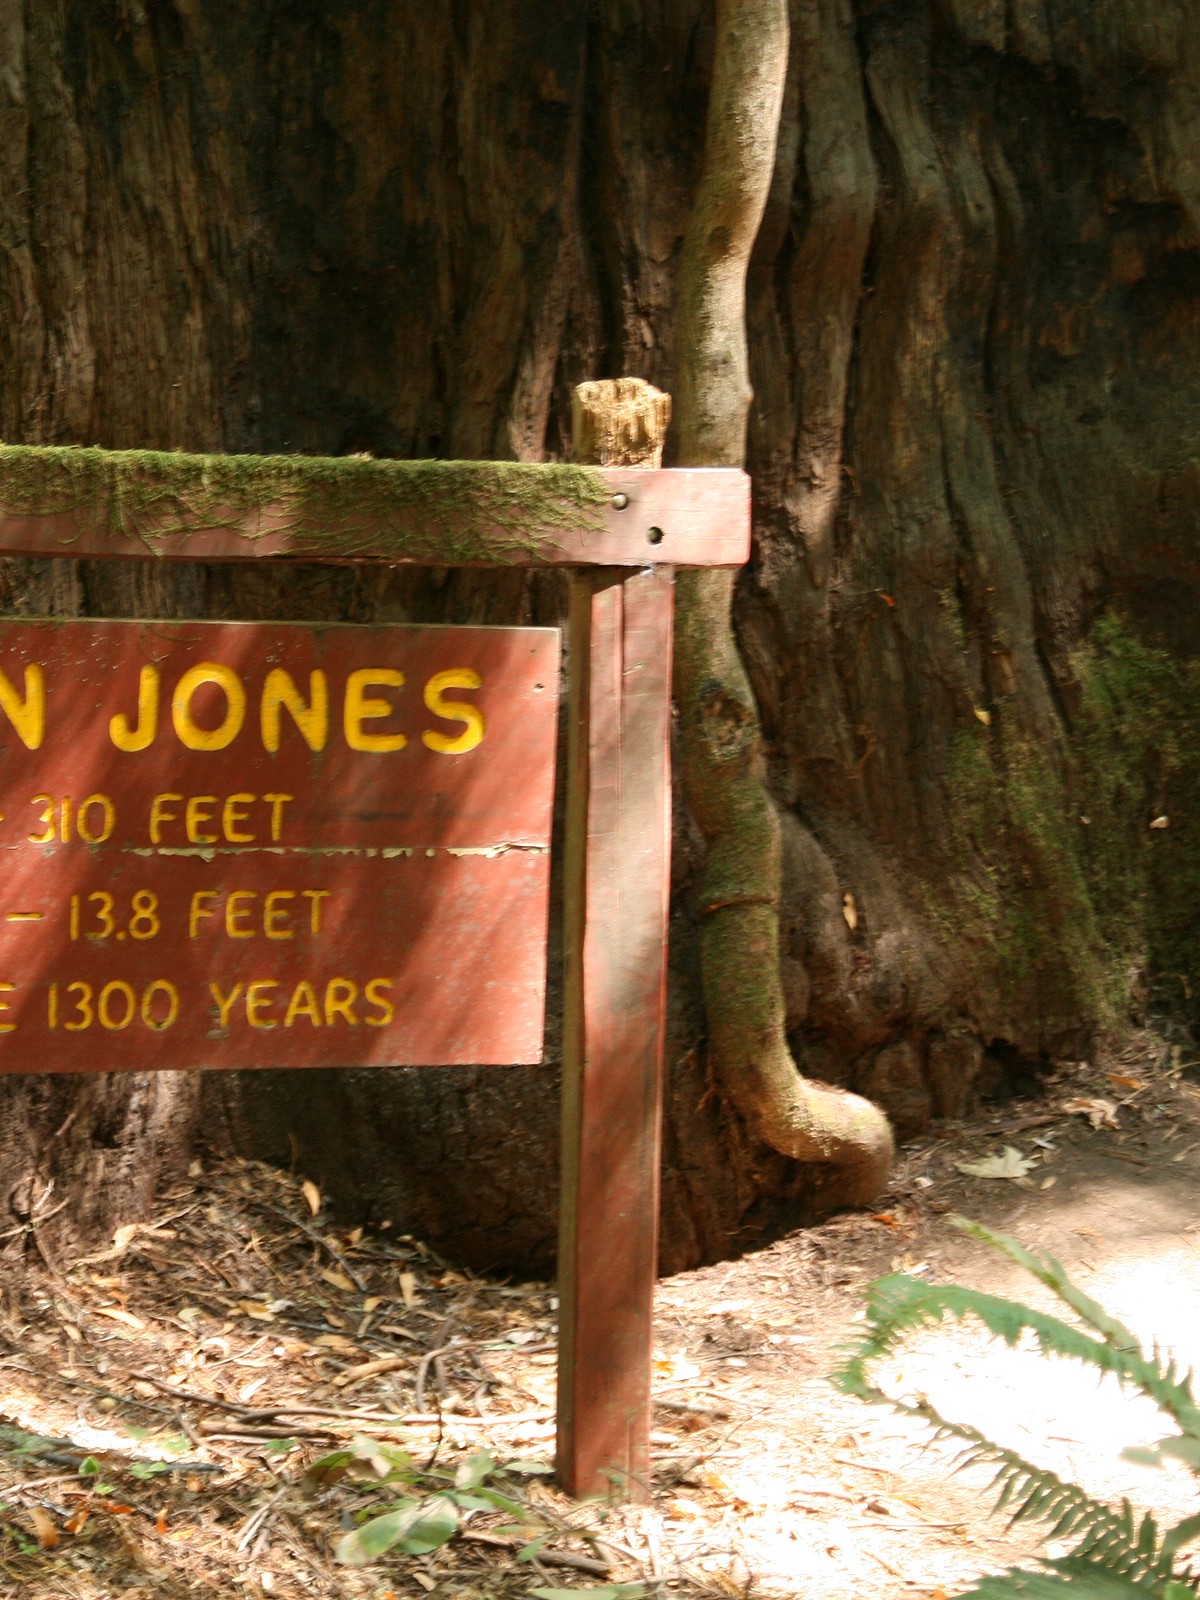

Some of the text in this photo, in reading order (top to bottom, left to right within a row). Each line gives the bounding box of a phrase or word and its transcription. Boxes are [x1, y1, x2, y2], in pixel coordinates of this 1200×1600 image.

[108, 661, 487, 755] JONES
[27, 792, 117, 845] 310
[148, 792, 294, 845] FEET
[69, 889, 162, 942] 13.8
[187, 888, 332, 940] FEET
[47, 980, 181, 1032] 1300
[208, 976, 396, 1029] YEARS
